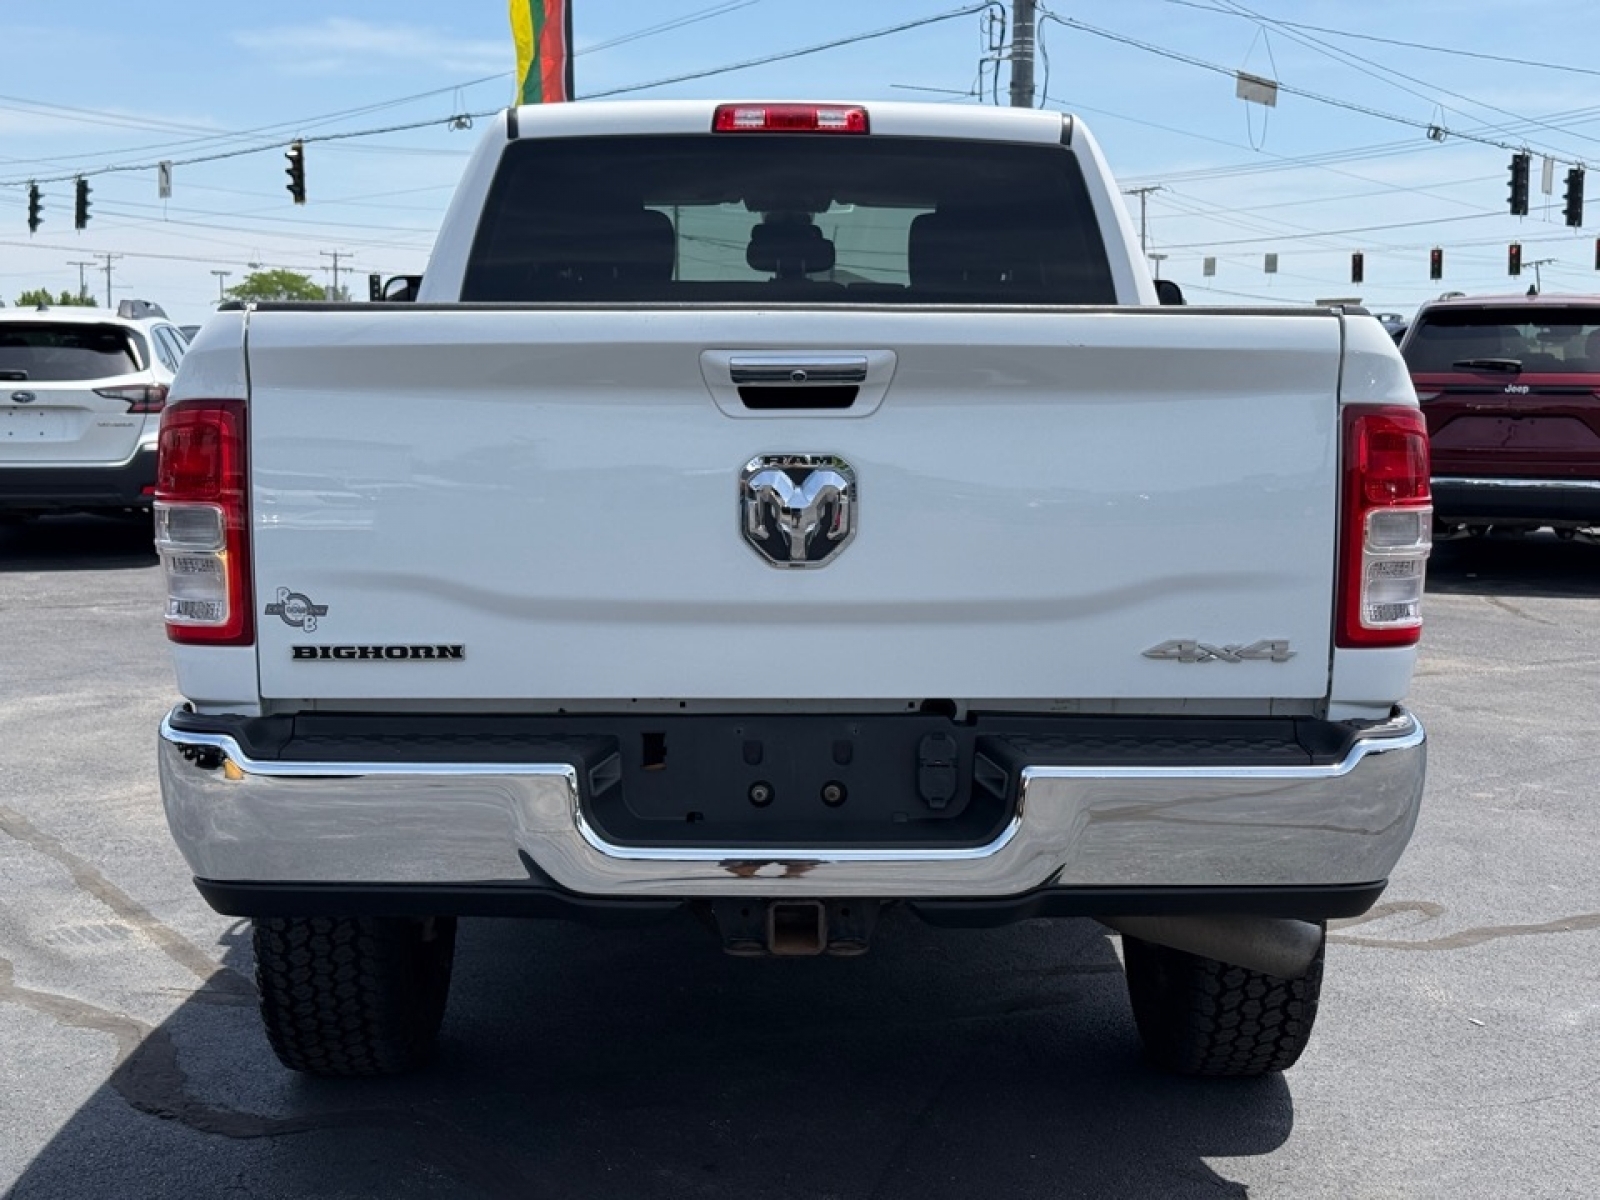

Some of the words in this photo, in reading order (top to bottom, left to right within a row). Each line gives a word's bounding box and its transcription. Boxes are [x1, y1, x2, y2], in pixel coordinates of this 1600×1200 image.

[1505, 384, 1529, 394] Jeep
[763, 456, 833, 466] RAM
[292, 645, 463, 660] BIGHORN
